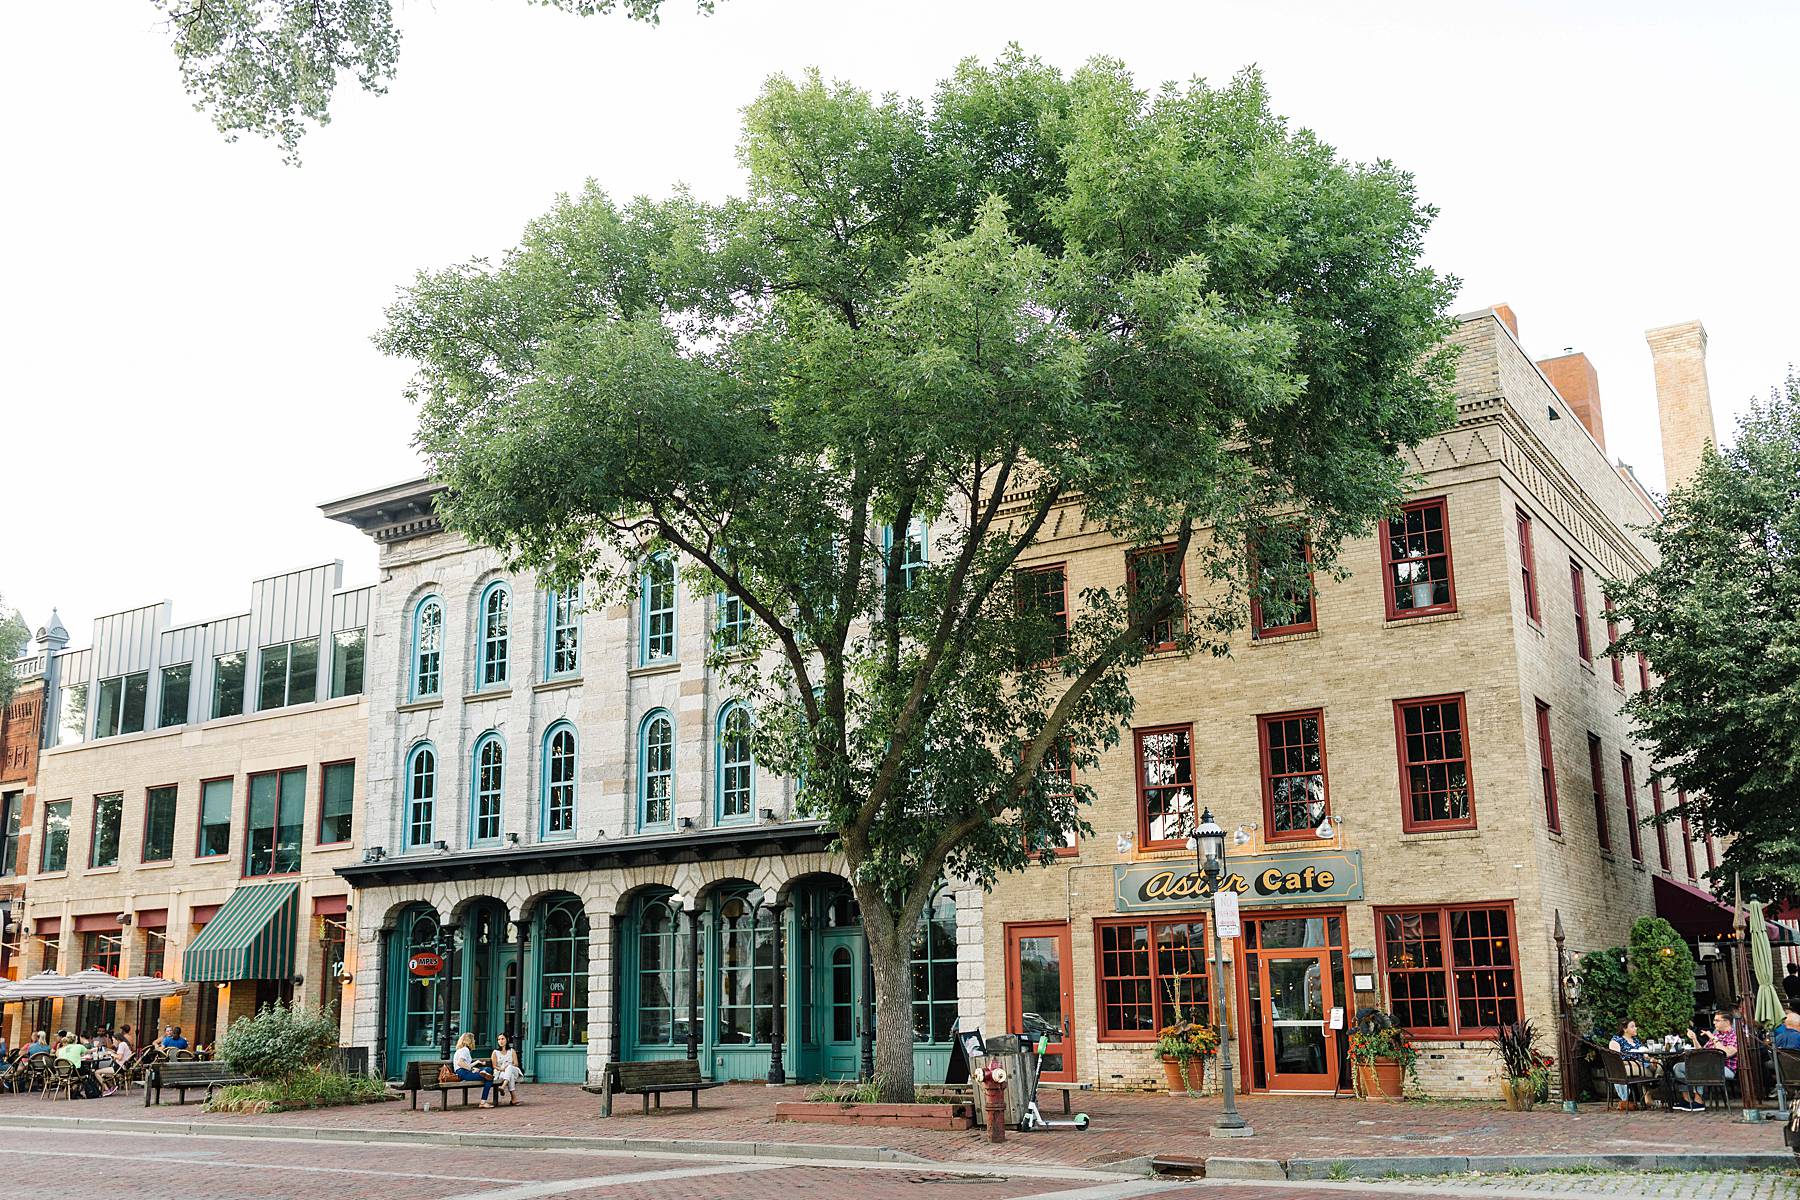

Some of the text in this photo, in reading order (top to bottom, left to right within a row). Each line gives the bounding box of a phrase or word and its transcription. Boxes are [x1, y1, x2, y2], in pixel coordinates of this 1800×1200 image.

[1259, 866, 1334, 893] Cafe
[418, 957, 439, 966] MPLS
[550, 982, 565, 991] OPEN
